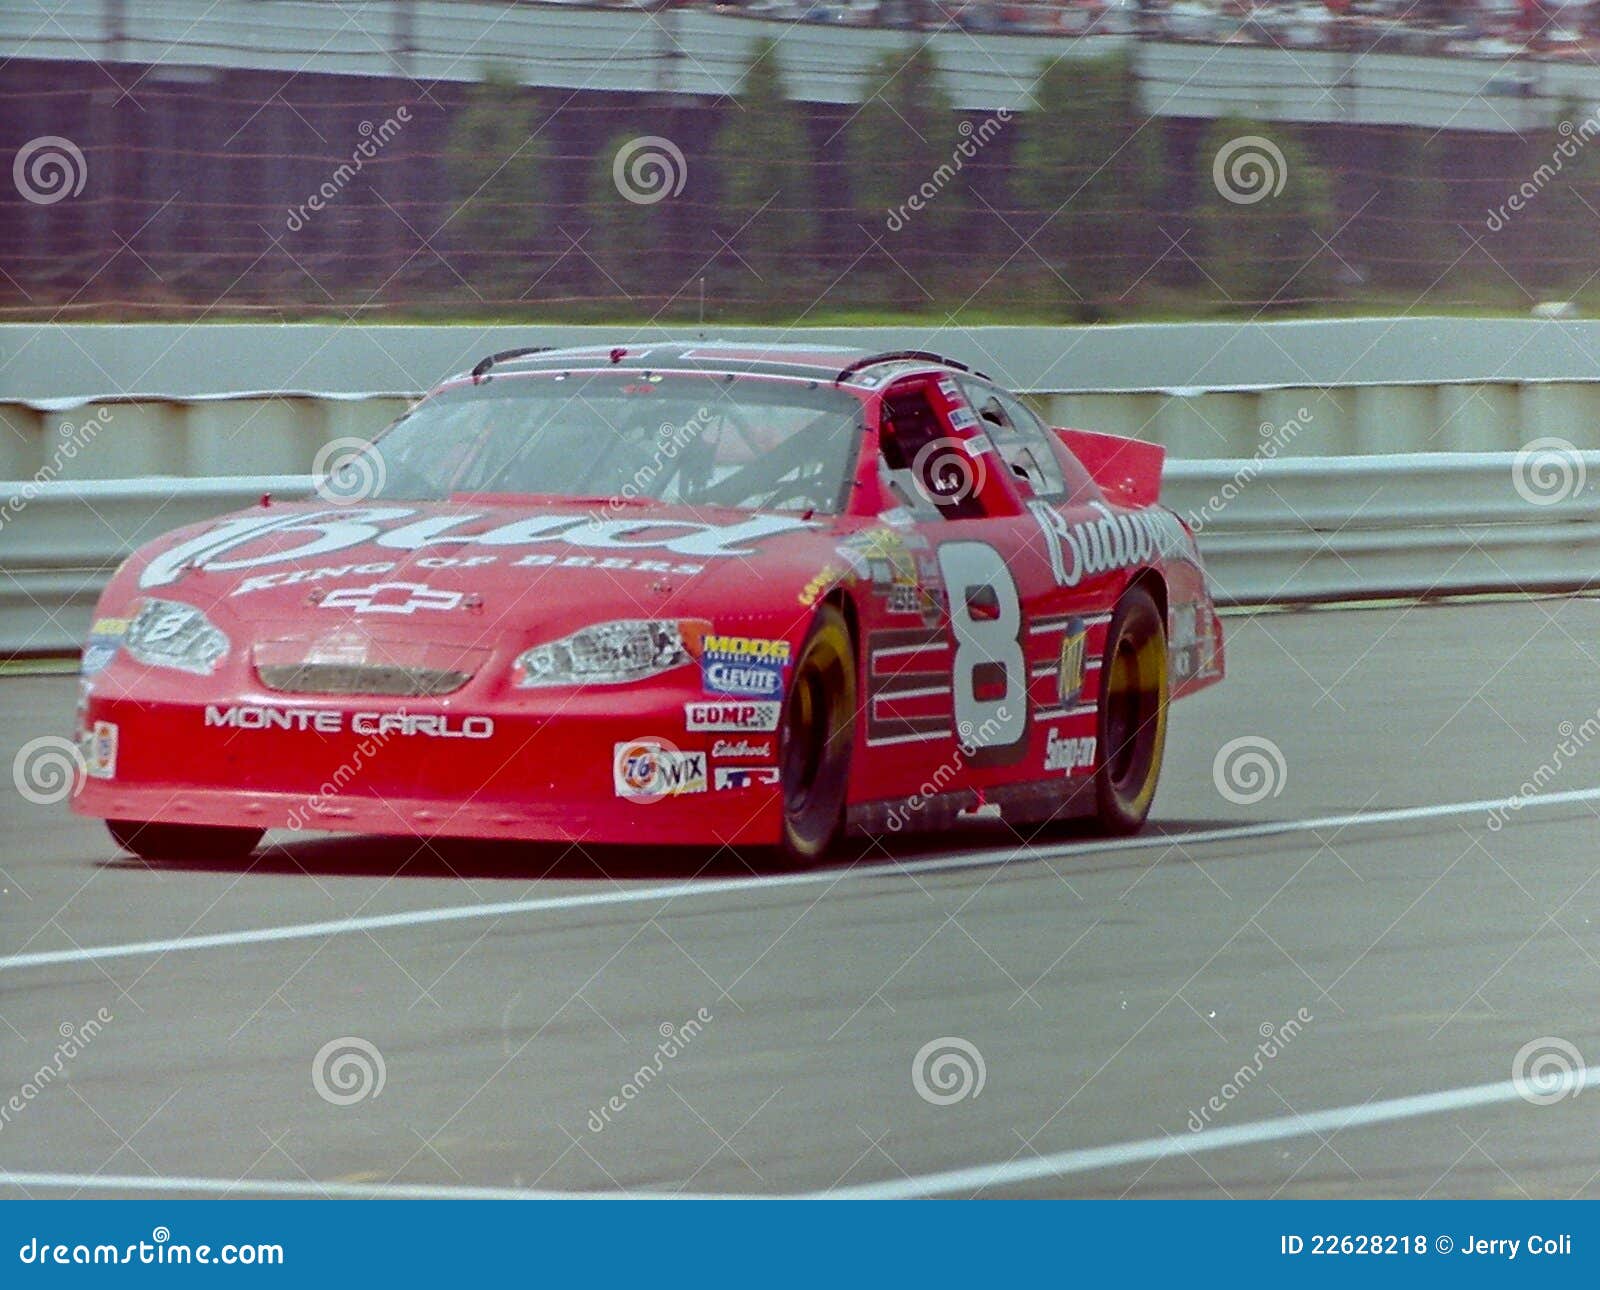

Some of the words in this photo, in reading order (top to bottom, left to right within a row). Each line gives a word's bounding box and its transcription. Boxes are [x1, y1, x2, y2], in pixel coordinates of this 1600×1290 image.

[140, 507, 826, 589] Bud
[416, 556, 498, 569] OF
[705, 635, 791, 659] MOOG
[937, 541, 1028, 746] 8
[708, 663, 776, 690] CLEVITE
[204, 705, 342, 733] MONTE
[352, 711, 495, 739] CARLO
[692, 706, 756, 724] COMP
[628, 756, 650, 778] 76
[659, 755, 703, 787] WIX
